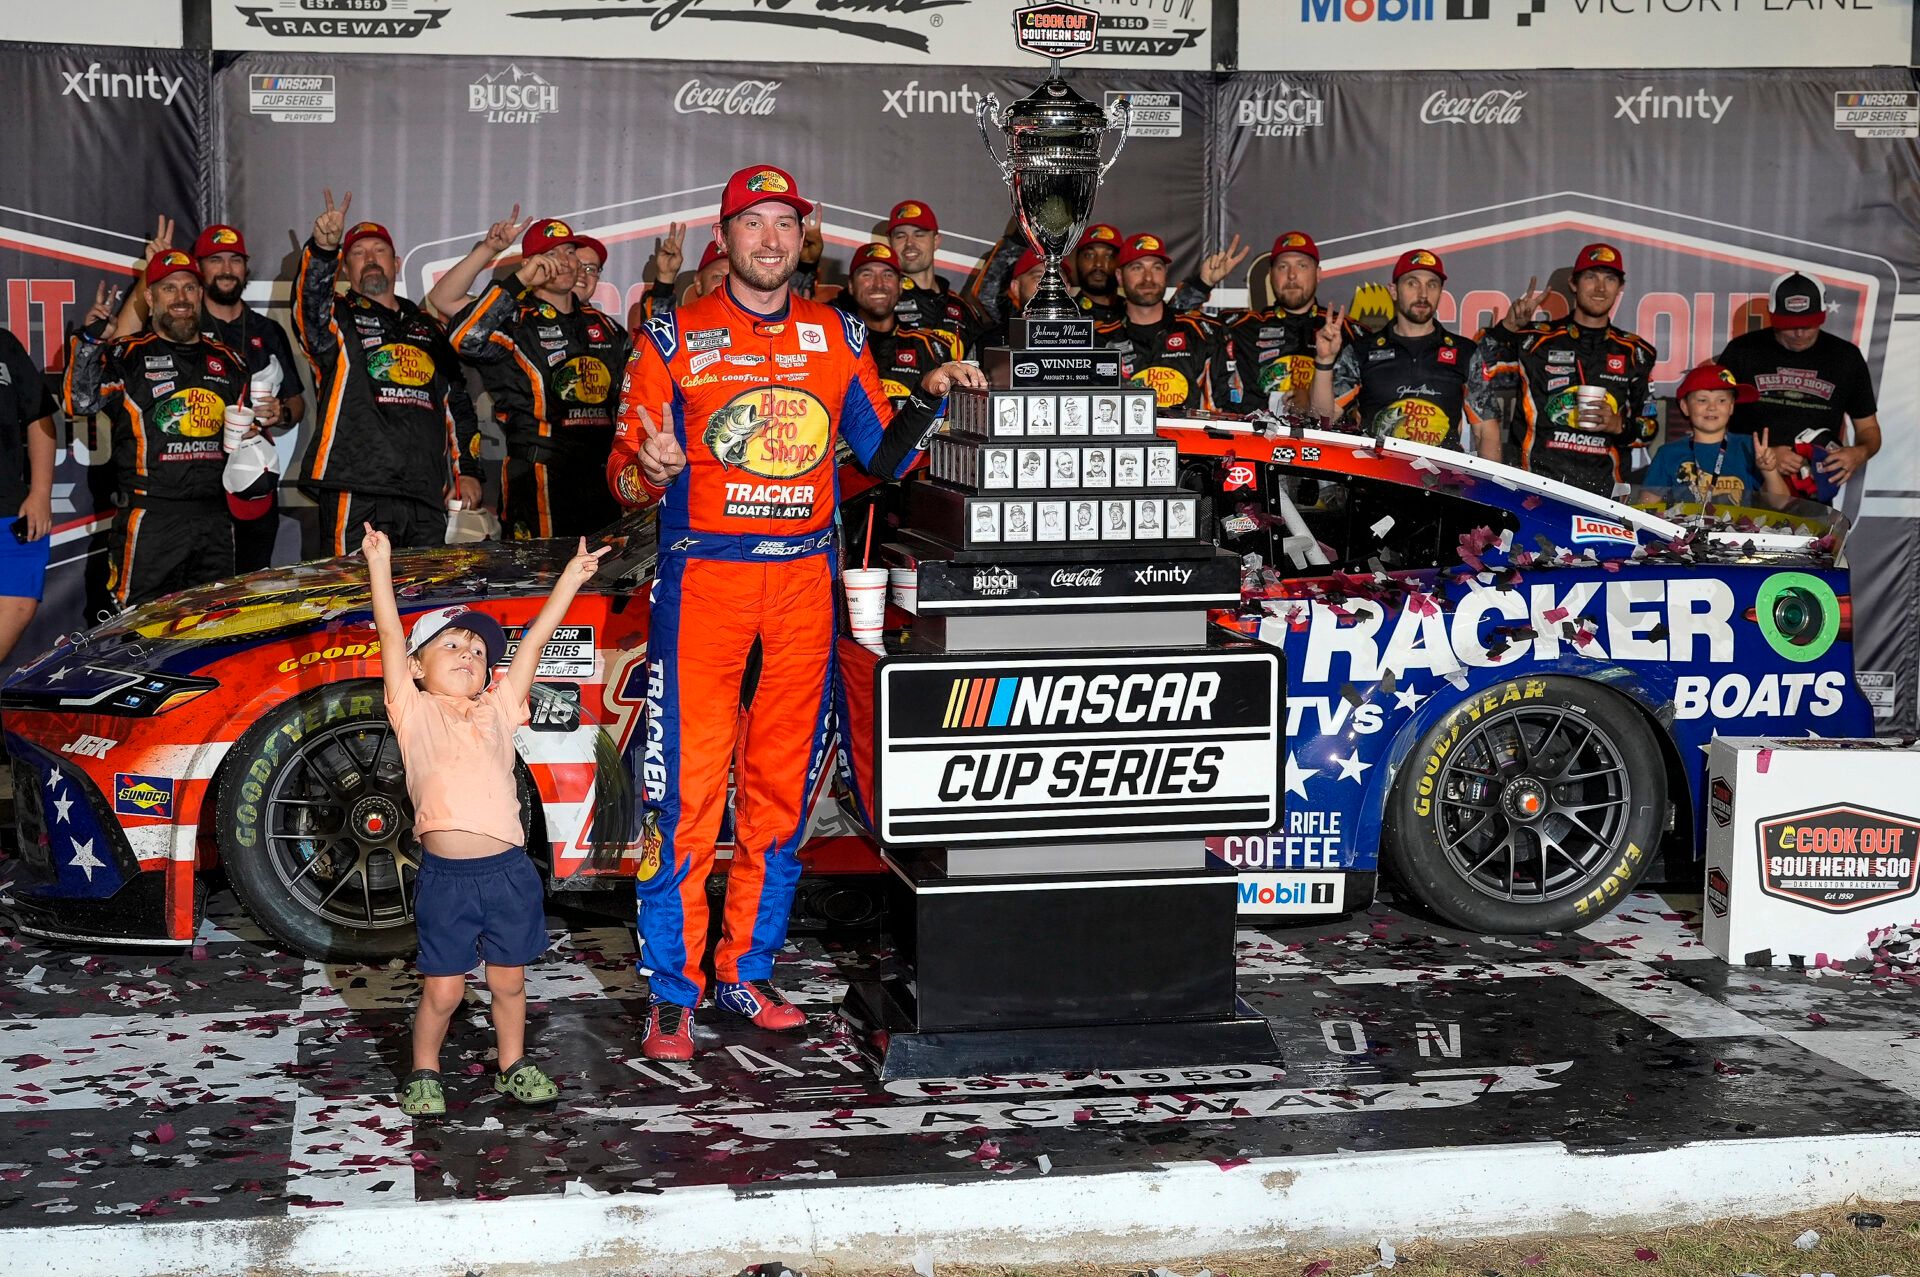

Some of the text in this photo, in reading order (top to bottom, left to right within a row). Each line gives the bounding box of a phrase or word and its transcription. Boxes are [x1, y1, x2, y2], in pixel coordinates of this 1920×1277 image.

[347, 0, 381, 10] 1950
[283, 21, 406, 36] RACEWAY
[1112, 18, 1143, 28] 1950
[1022, 29, 1092, 42] SOUTHERN 500
[61, 63, 183, 106] xfinity
[276, 78, 323, 90] NASCAR
[262, 95, 324, 106] CUP SERIES
[468, 84, 559, 113] BUSCH
[674, 79, 782, 116] Coca-Cola
[1614, 86, 1733, 124] xfinity
[1861, 94, 1908, 105] NASCAR
[1238, 99, 1324, 127] BUSCH
[1420, 90, 1528, 125] Coca-Cola
[284, 113, 323, 121] PLAYOFFS
[487, 111, 540, 123] LIGHT
[1137, 111, 1171, 121] SERIES
[1847, 111, 1908, 121] CUP SERIES
[1135, 128, 1170, 136] PLAYOFFS
[1255, 124, 1305, 137] LIGHT
[1867, 128, 1906, 136] PLAYOFFS
[1032, 325, 1060, 339] Johnny
[395, 345, 422, 358] Bass
[399, 356, 417, 367] Pro
[579, 358, 602, 370] Bass
[692, 352, 718, 369] Lance
[1040, 359, 1091, 369] WINNER
[400, 367, 431, 382] Shops
[581, 370, 599, 382] Pro
[681, 373, 719, 388] Cabela's
[722, 373, 770, 382] GOODYEAR
[1148, 369, 1175, 382] Bass
[1291, 369, 1310, 380] Pro
[1782, 376, 1802, 385] PRO
[381, 387, 430, 400] TRACKER
[583, 382, 608, 398] Shops
[1151, 381, 1169, 391] Pro
[188, 390, 217, 404] Bass
[758, 392, 808, 417] Bass
[191, 403, 210, 416] Pro
[1405, 401, 1436, 416] Bass
[191, 416, 221, 432] Shops
[762, 417, 798, 439] Pro
[1405, 414, 1429, 428] Pro
[1406, 426, 1442, 445] Shops
[1554, 431, 1606, 446] TRACKER
[166, 441, 220, 453] TRACKER
[761, 438, 817, 469] Shops
[725, 483, 814, 503] TRACKER
[727, 504, 774, 516] BOATS
[783, 507, 810, 517] ATVs
[1575, 516, 1635, 540] Lance
[973, 575, 1018, 590] BUSCH
[1051, 568, 1105, 587] Coca-Cola
[1134, 565, 1192, 585] xfinity
[552, 629, 580, 640] CAR
[1255, 577, 1735, 683] TRACKER
[543, 645, 580, 657] ERIES
[1011, 671, 1222, 727] NASCAR
[1674, 671, 1847, 720] BOATS
[1286, 696, 1384, 736] TVs
[643, 659, 667, 802] TRACKER
[61, 734, 118, 759] JGR
[1413, 680, 1547, 818] GOODYEAR
[937, 746, 1225, 803] CUP SERIES
[121, 789, 169, 803] SUNOCO
[1290, 811, 1341, 835] RIFLE
[1224, 836, 1341, 867] COFFEE
[1770, 856, 1910, 878] SOUTHERN 500
[1573, 841, 1642, 918] EAGLE
[1849, 881, 1888, 889] RACEWAY
[1238, 883, 1306, 904] Mobil
[1824, 891, 1854, 900] Est 1950
[1108, 1069, 1252, 1086] 1950
